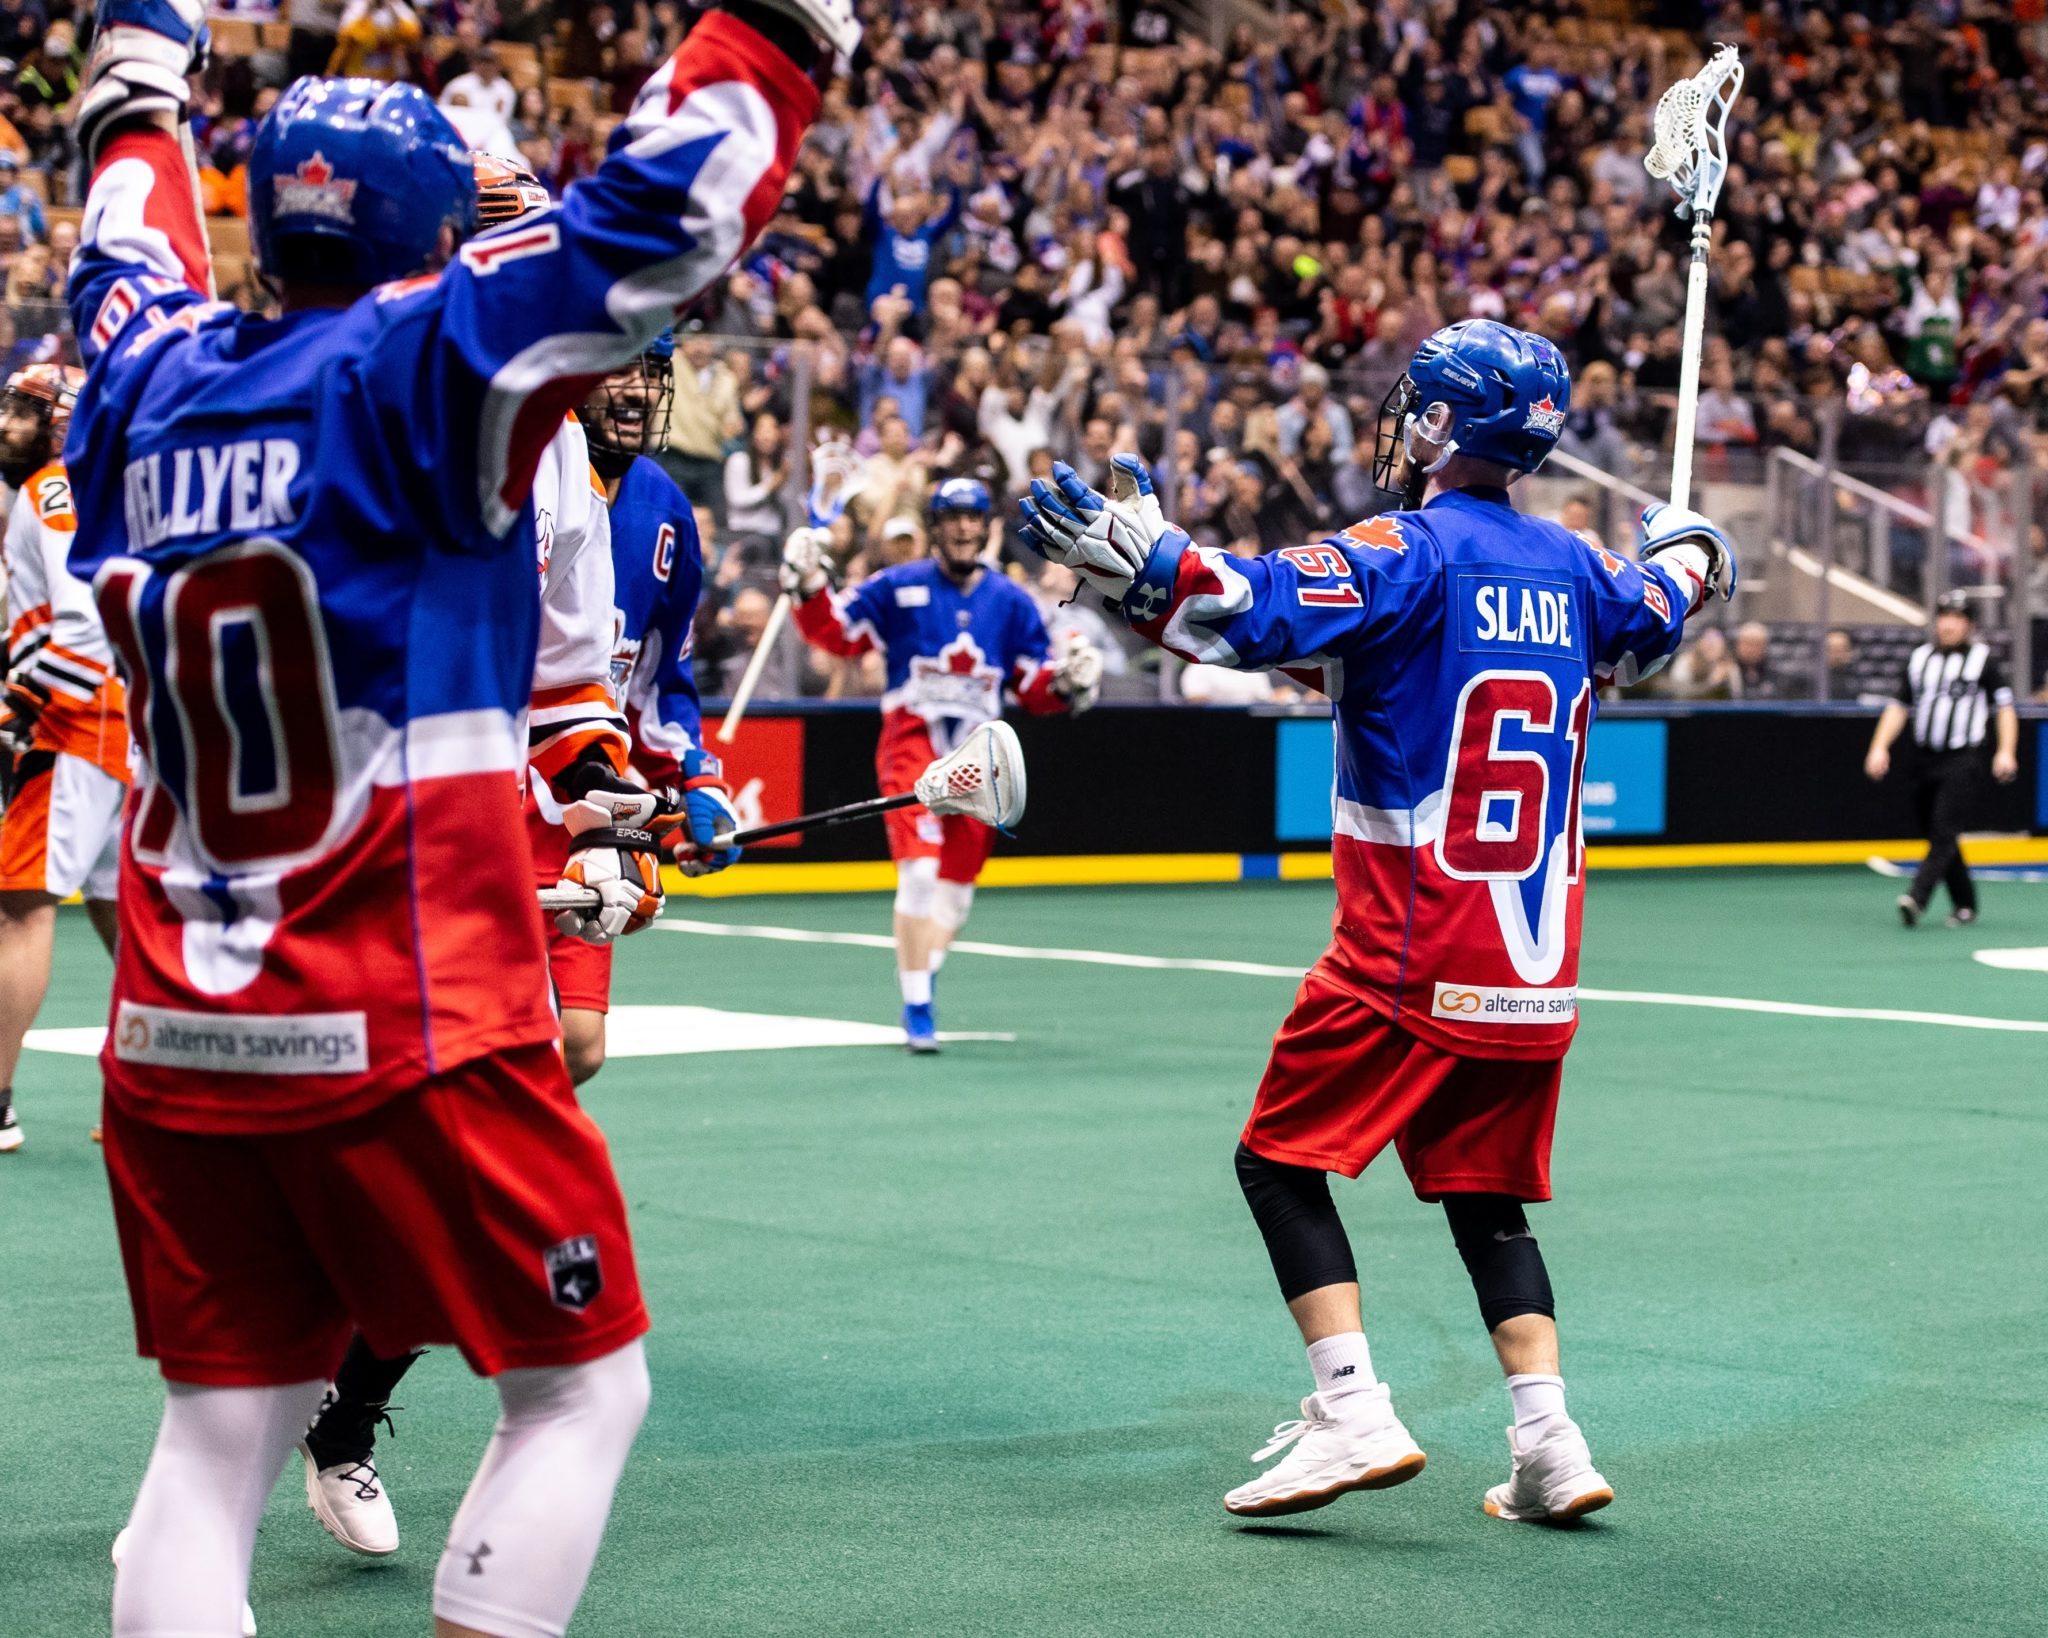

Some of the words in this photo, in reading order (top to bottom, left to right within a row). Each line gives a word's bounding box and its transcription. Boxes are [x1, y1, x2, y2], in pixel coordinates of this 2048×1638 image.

[1525, 411, 1560, 436] ROCK
[653, 522, 676, 583] C
[1278, 544, 1364, 608] 61
[1475, 585, 1572, 648] SLADE
[93, 536, 347, 873] 10
[1434, 669, 1592, 885] 61
[616, 828, 652, 841] EPOCH
[1484, 993, 1545, 1013] alterna
[153, 1018, 237, 1055] alterna
[242, 1024, 357, 1065] savings
